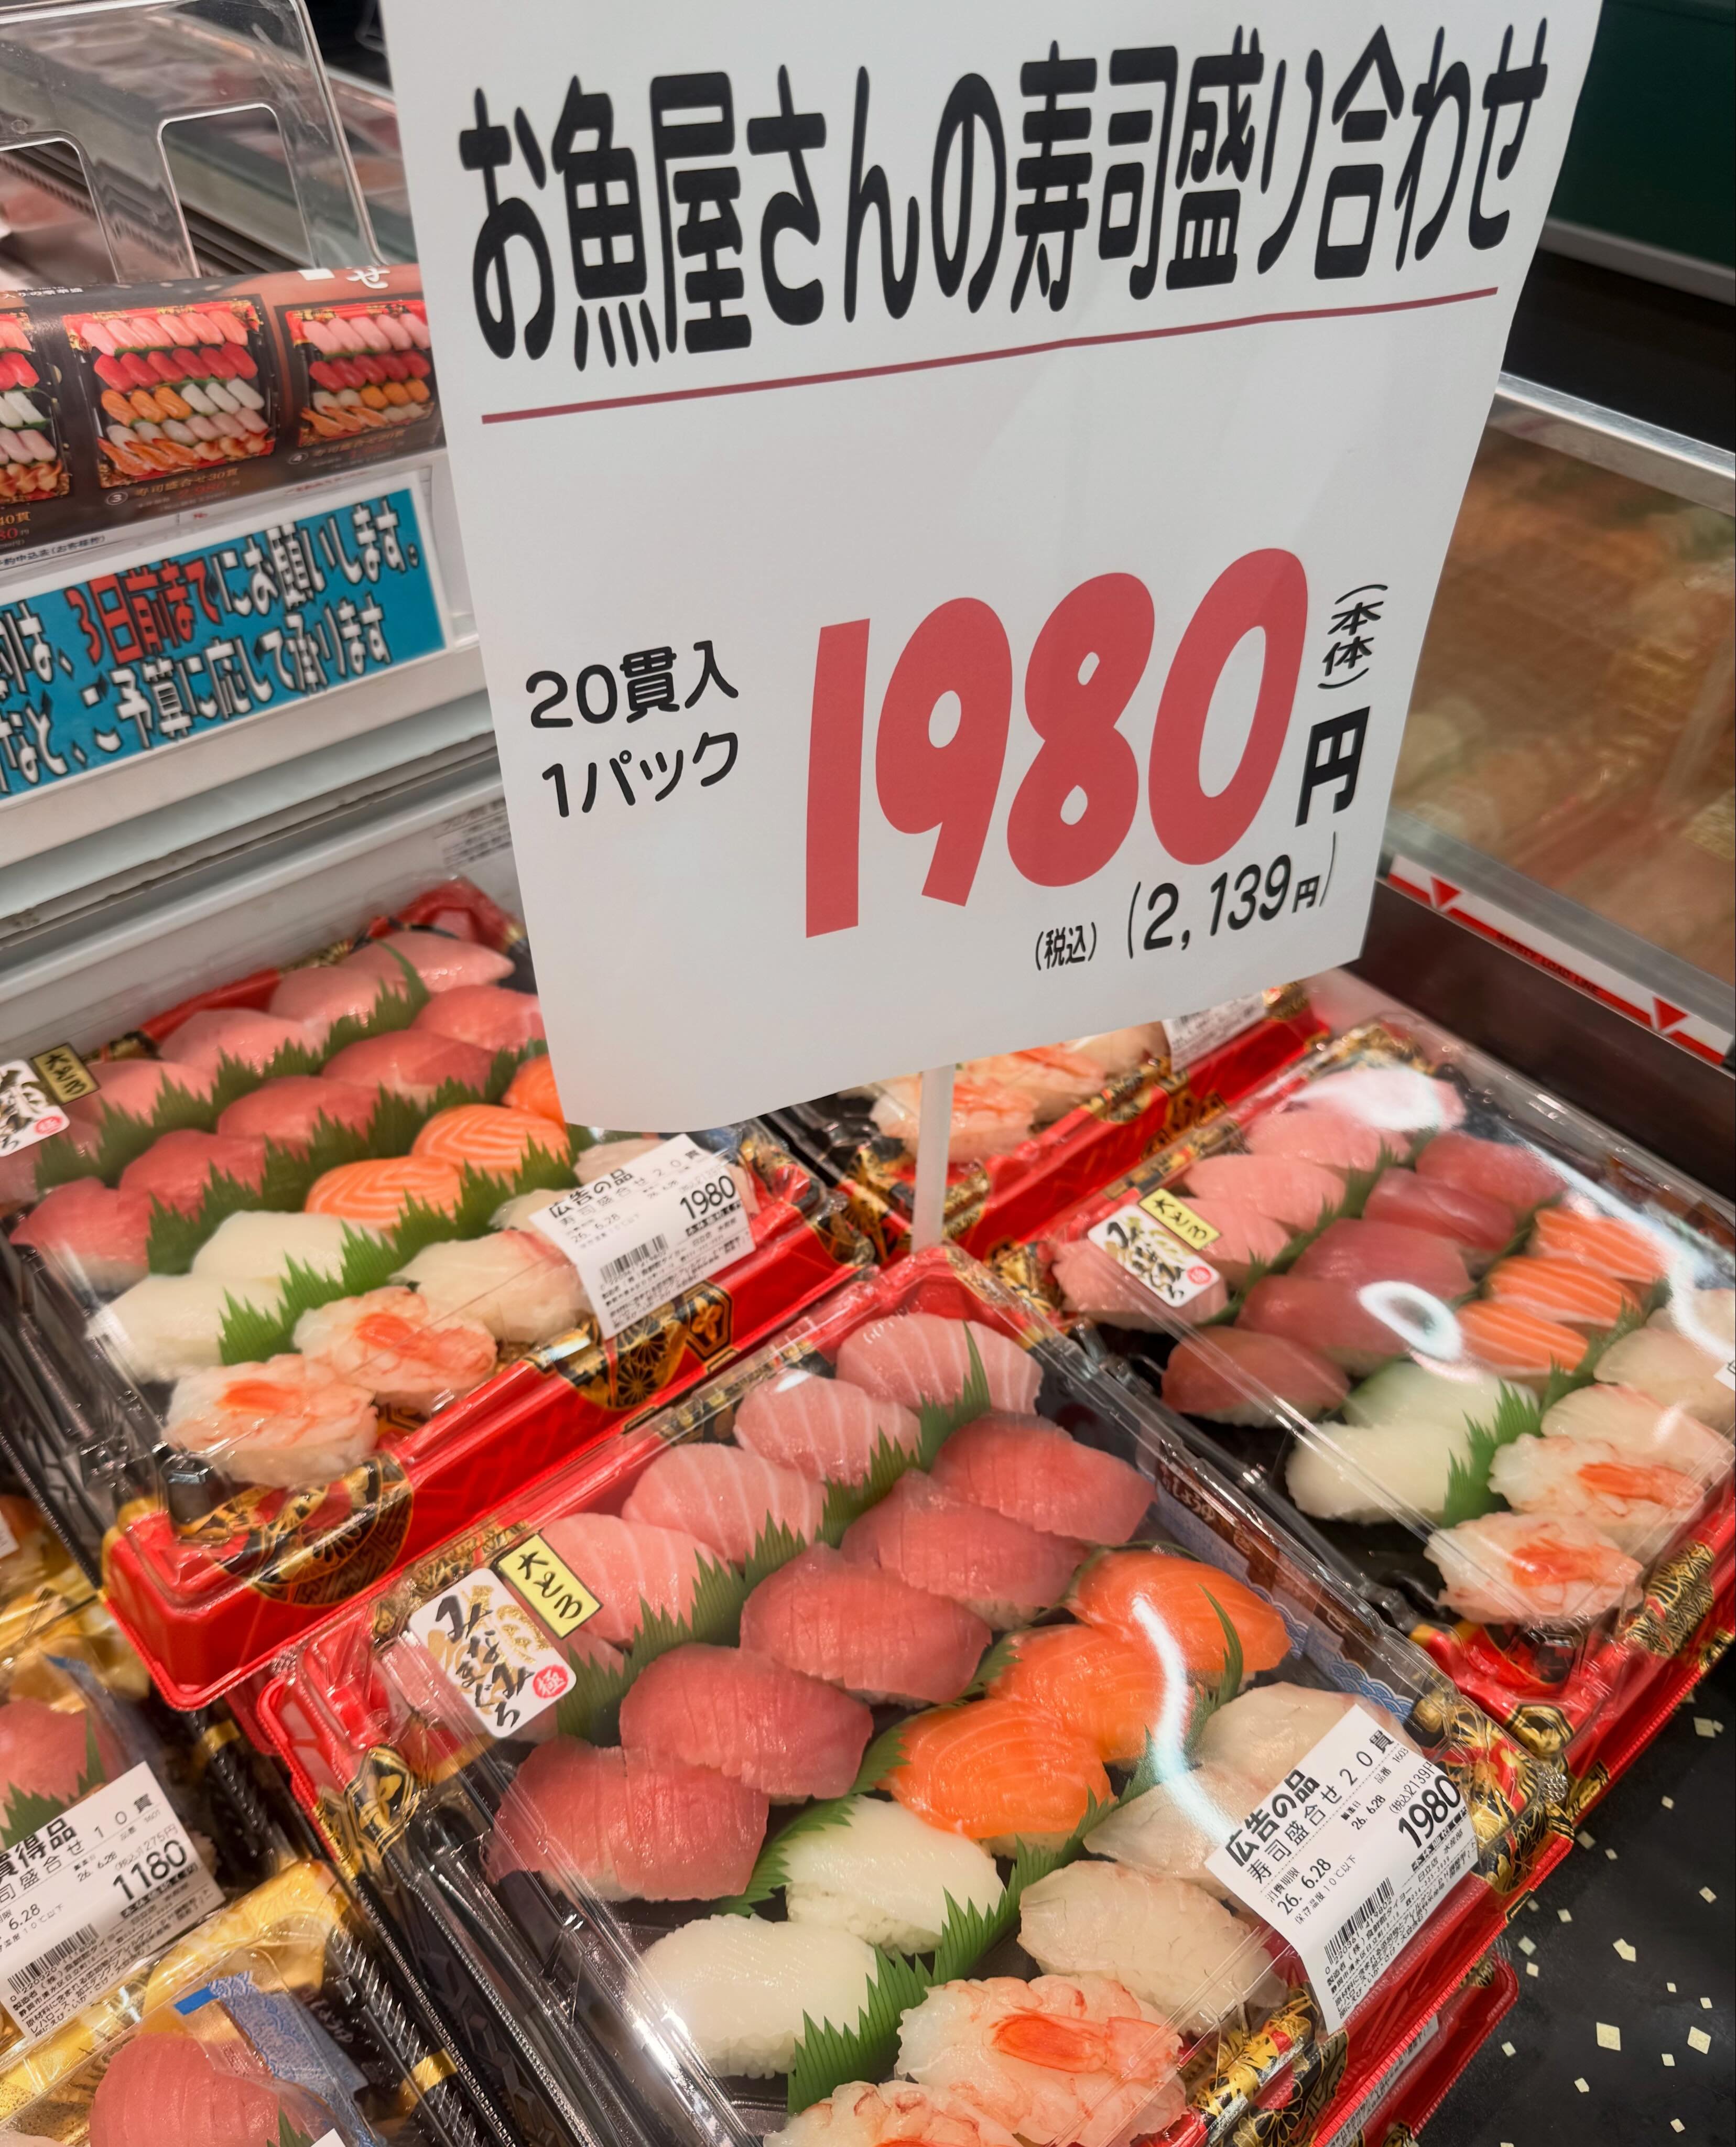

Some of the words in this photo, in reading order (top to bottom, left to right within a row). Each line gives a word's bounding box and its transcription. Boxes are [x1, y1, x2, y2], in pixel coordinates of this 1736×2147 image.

[459, 17, 1547, 371] お魚屋さんの寿司盛り合わせ
[1318, 584, 1388, 689] (本体)
[526, 641, 739, 728] 20貫入
[542, 732, 738, 818] 1パック
[806, 548, 1308, 938] 1980
[1296, 706, 1370, 827] 円
[1036, 922, 1097, 970] (税込)
[1128, 832, 1336, 959] (2,139円)
[549, 1169, 633, 1218] 広告の品
[680, 1175, 735, 1220] 1980
[517, 1551, 584, 1619] 大とろ
[1225, 1769, 1320, 1867] 広告の品
[1246, 1729, 1395, 1885] 寿司盛合せ20貫
[1366, 1794, 1386, 1815] 6.28
[1398, 1775, 1460, 1849] 1980
[113, 1839, 187, 1902] 1180
[1266, 1866, 1300, 1903] 消費期限
[1301, 1858, 1332, 1890] 6.28
